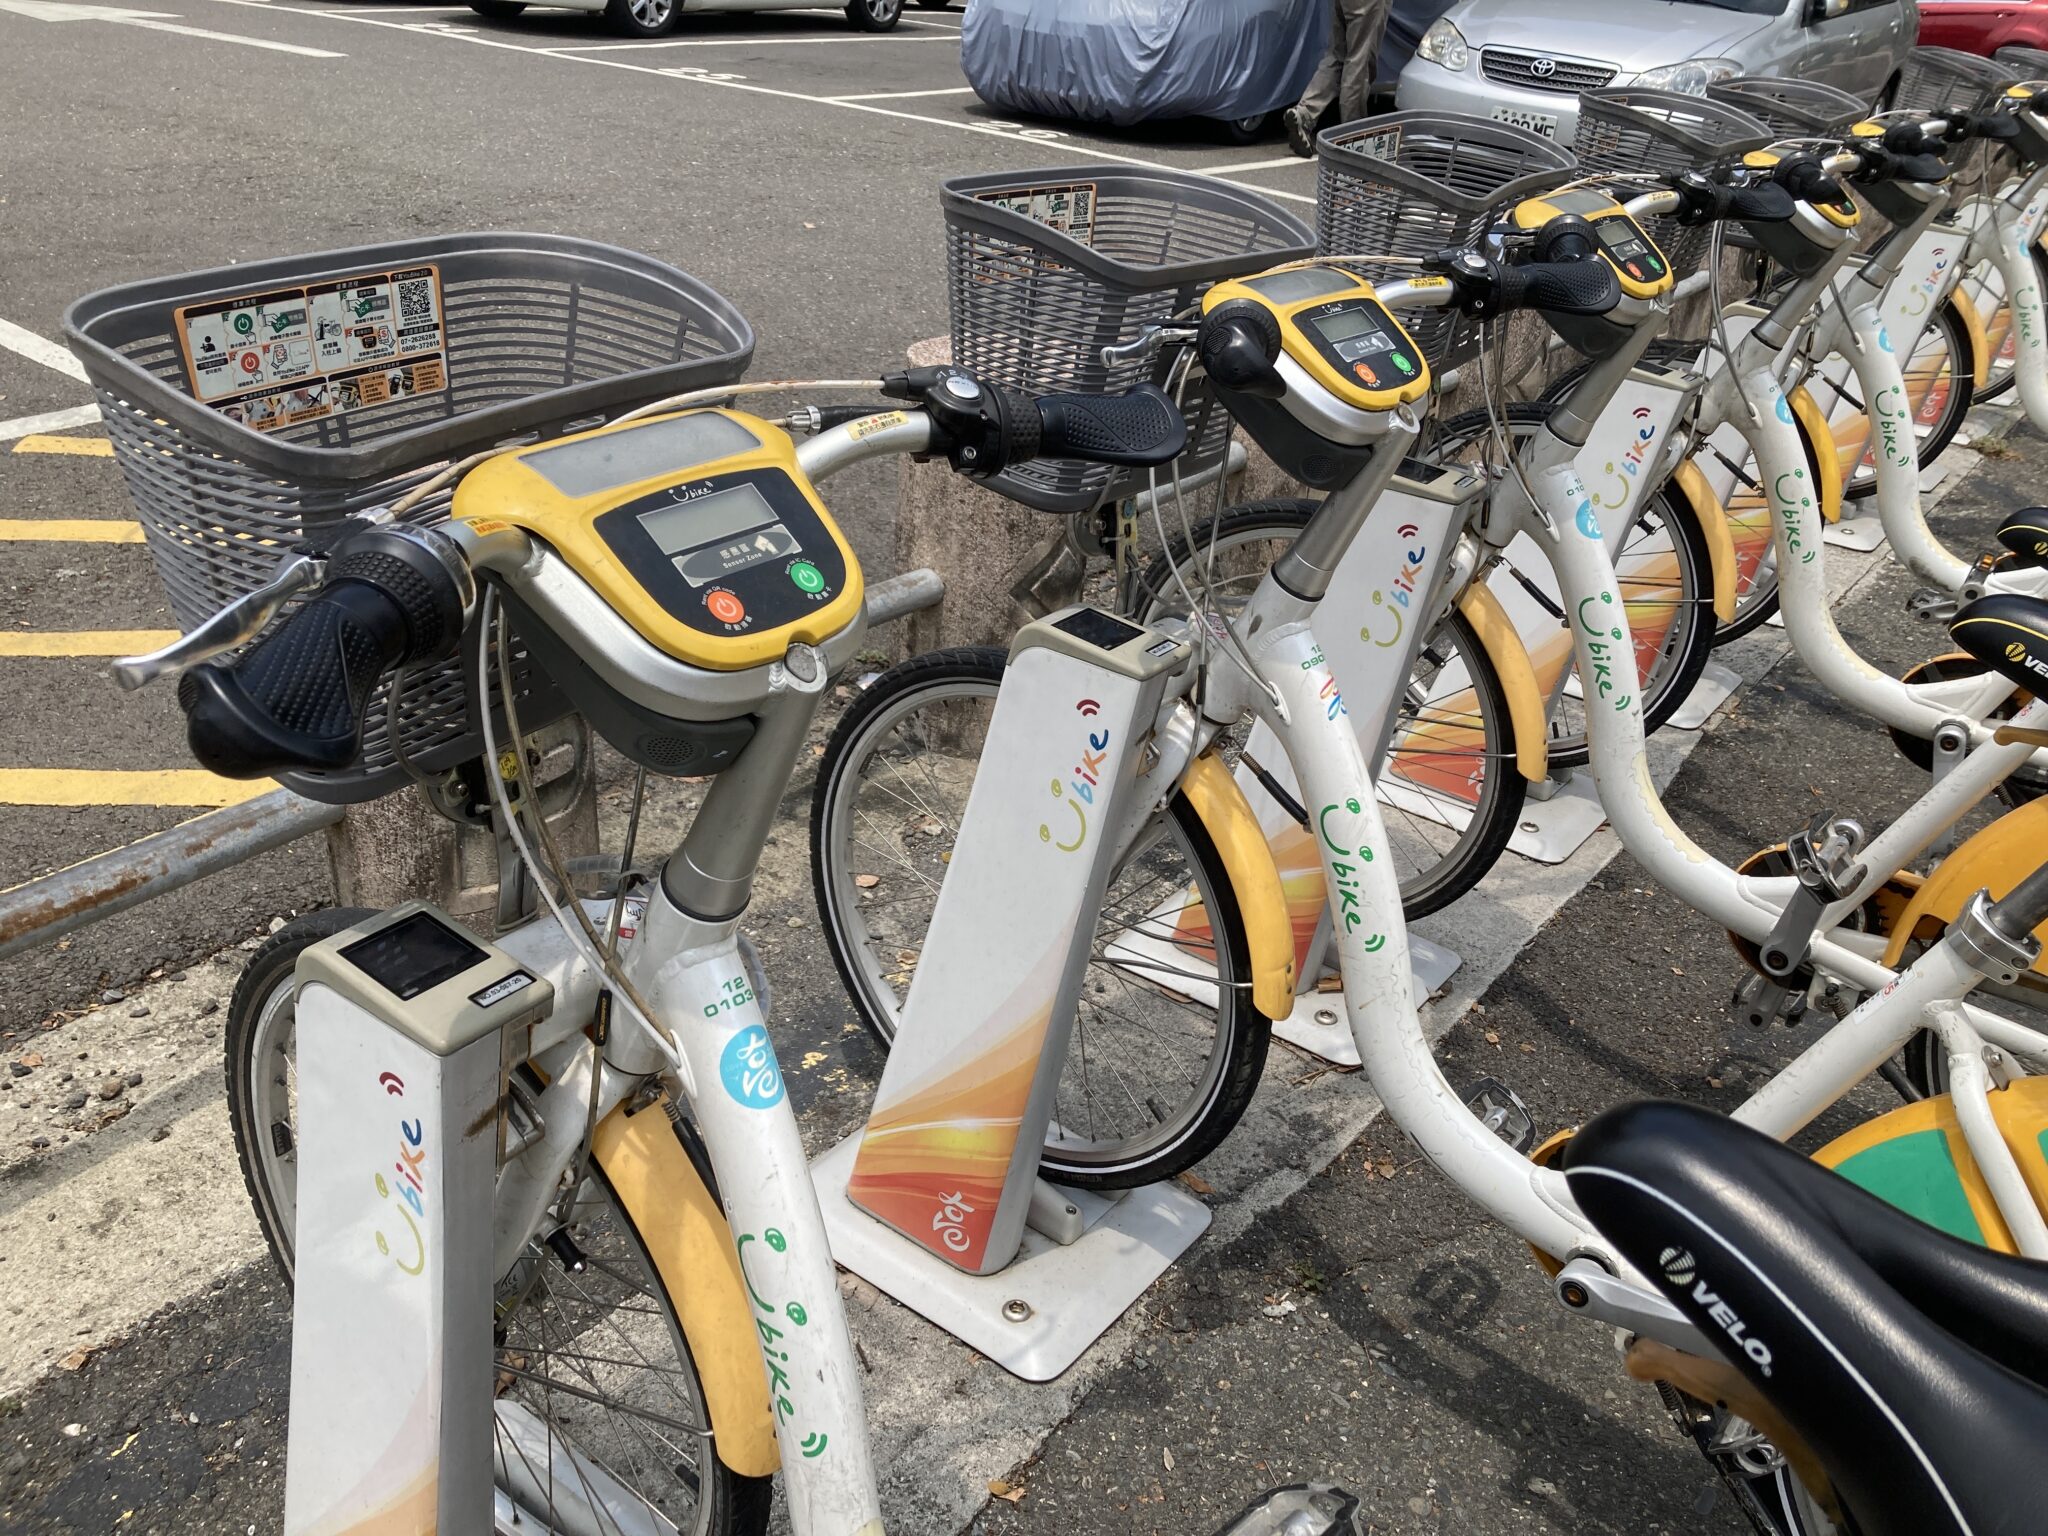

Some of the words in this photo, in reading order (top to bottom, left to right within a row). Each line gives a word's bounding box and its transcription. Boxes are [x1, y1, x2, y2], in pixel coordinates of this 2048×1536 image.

[722, 557, 746, 570] Sensor
[746, 552, 763, 562] Zone
[722, 976, 746, 993] 12
[703, 991, 754, 1018] 0103
